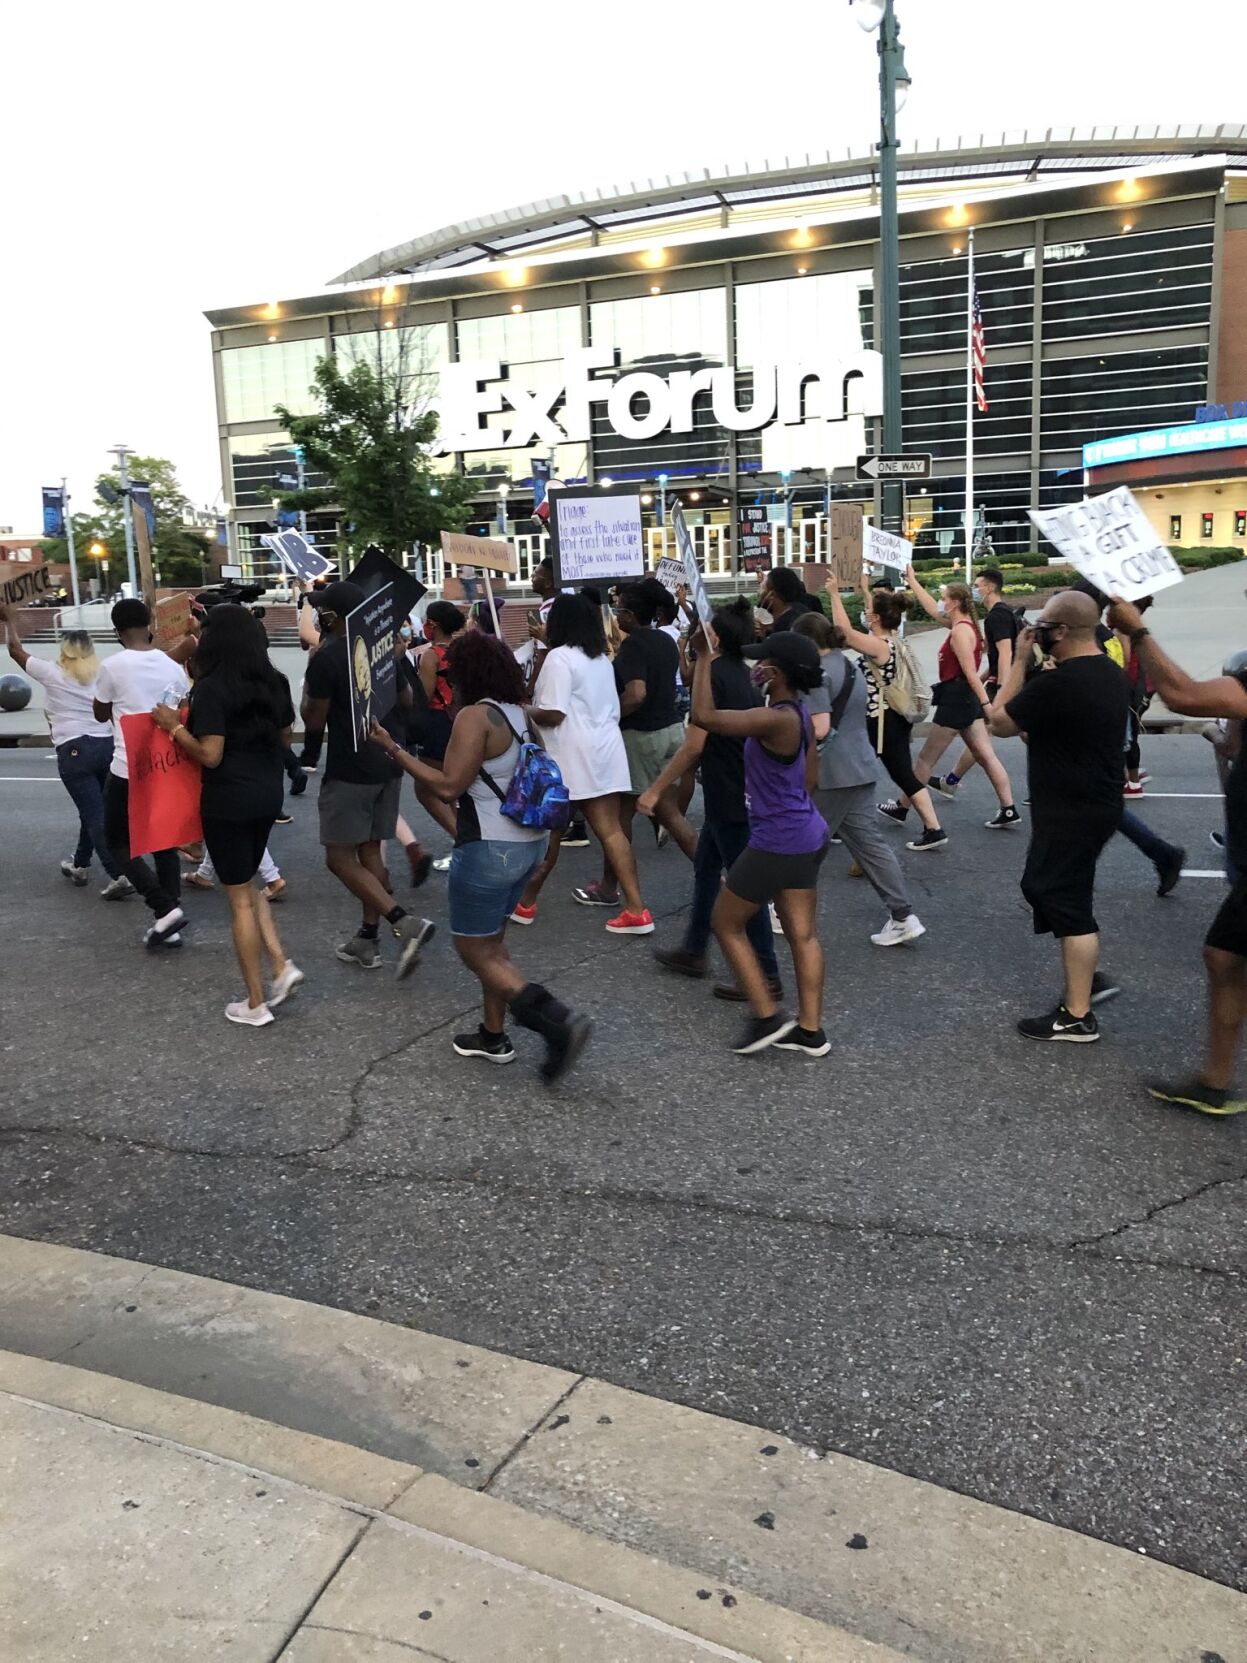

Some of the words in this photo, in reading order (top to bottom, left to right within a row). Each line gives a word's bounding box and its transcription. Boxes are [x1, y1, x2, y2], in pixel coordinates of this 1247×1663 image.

[878, 462, 897, 472] ONE
[902, 461, 923, 472] WAY
[562, 564, 584, 579] MOST
[371, 630, 395, 667] JUSTICE
